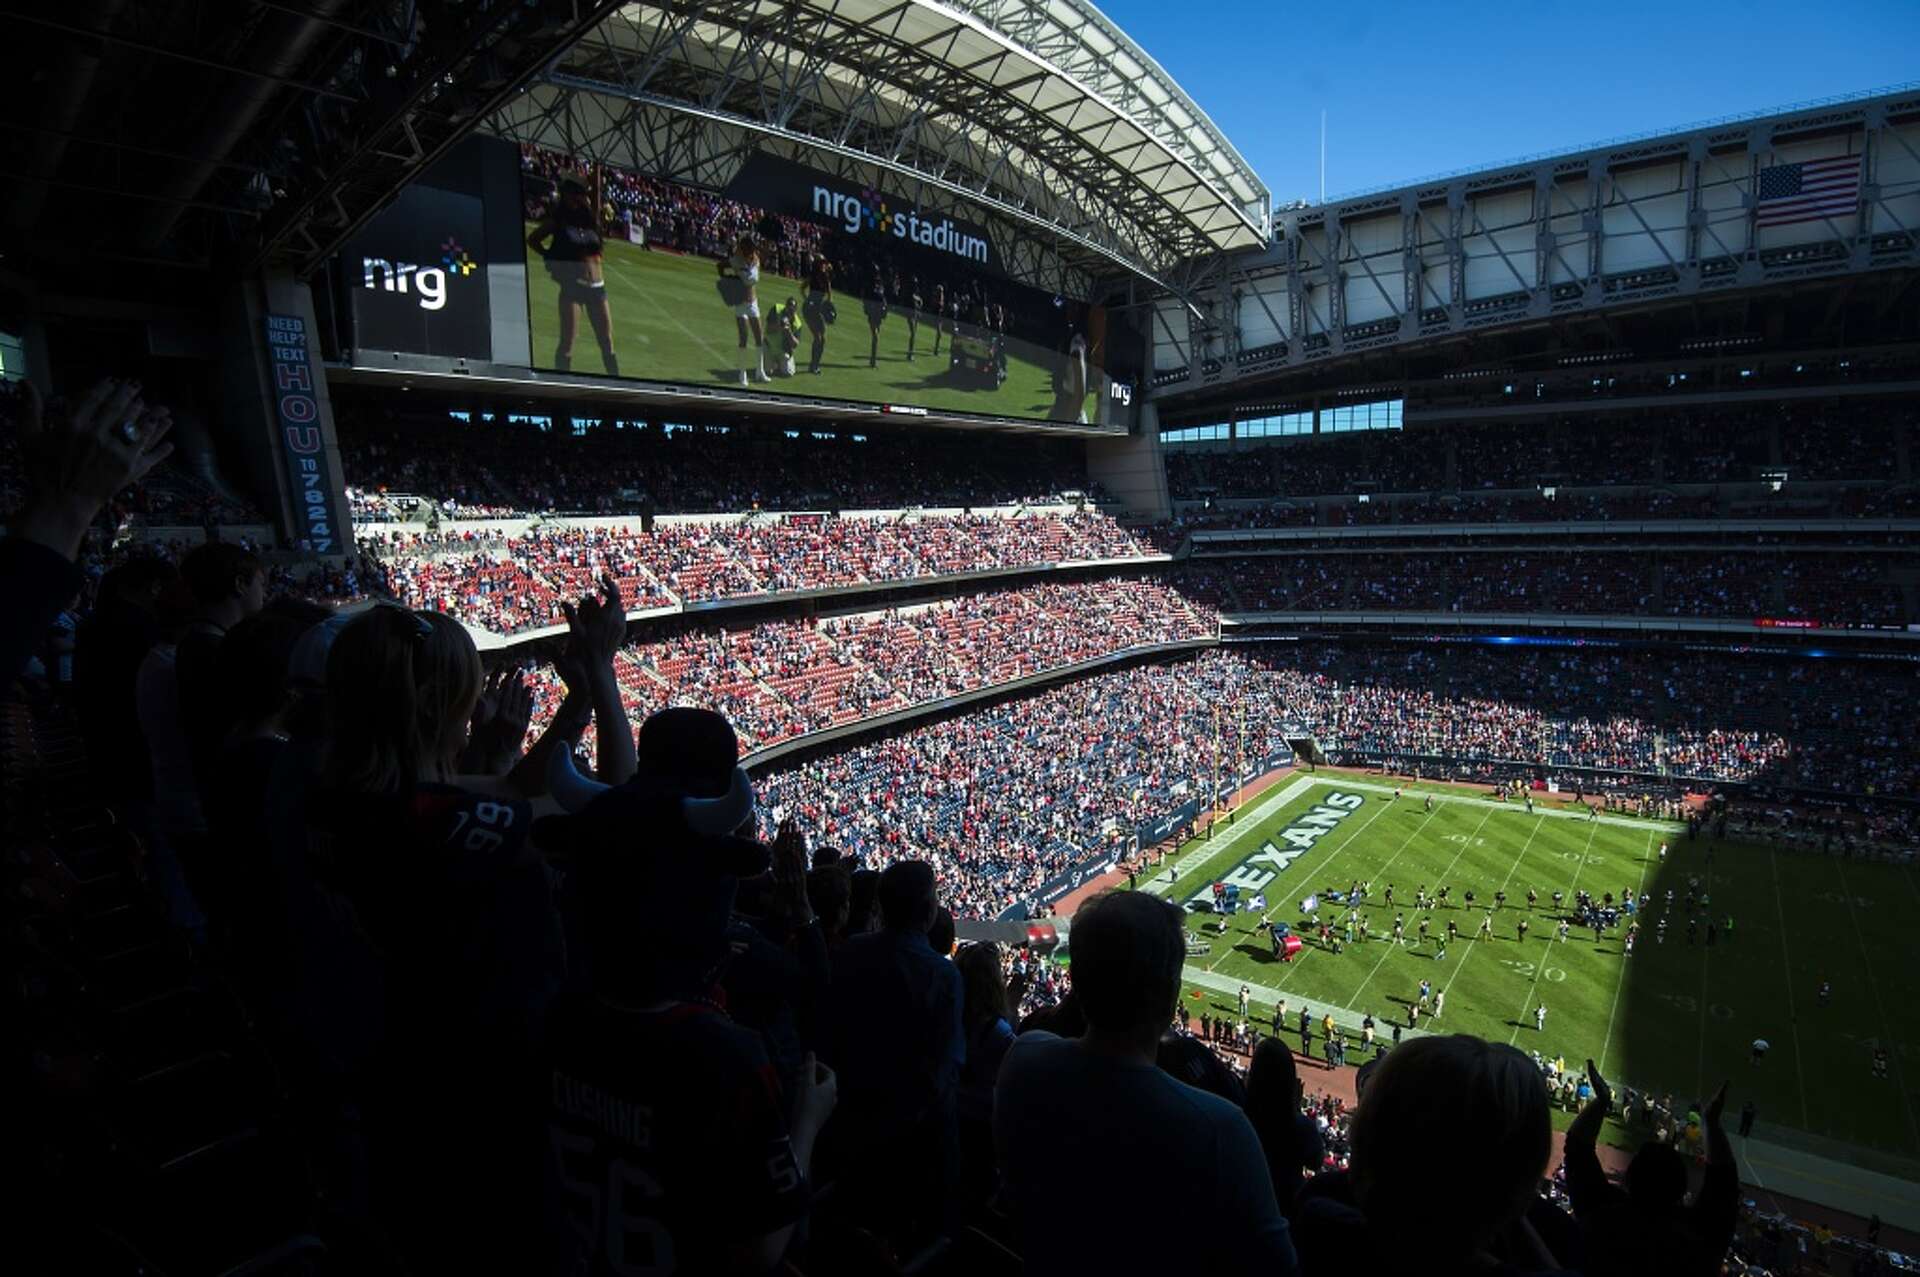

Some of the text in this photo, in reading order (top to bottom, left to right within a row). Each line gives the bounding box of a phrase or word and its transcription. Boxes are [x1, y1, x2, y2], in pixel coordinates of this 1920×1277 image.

[812, 185, 988, 264] nrg stadium
[362, 256, 448, 311] nrg
[268, 316, 304, 332] NEED
[269, 331, 307, 346] HELP?
[274, 346, 305, 361] TEXT
[276, 363, 322, 454] HOU
[551, 1068, 654, 1152] CUSHING
